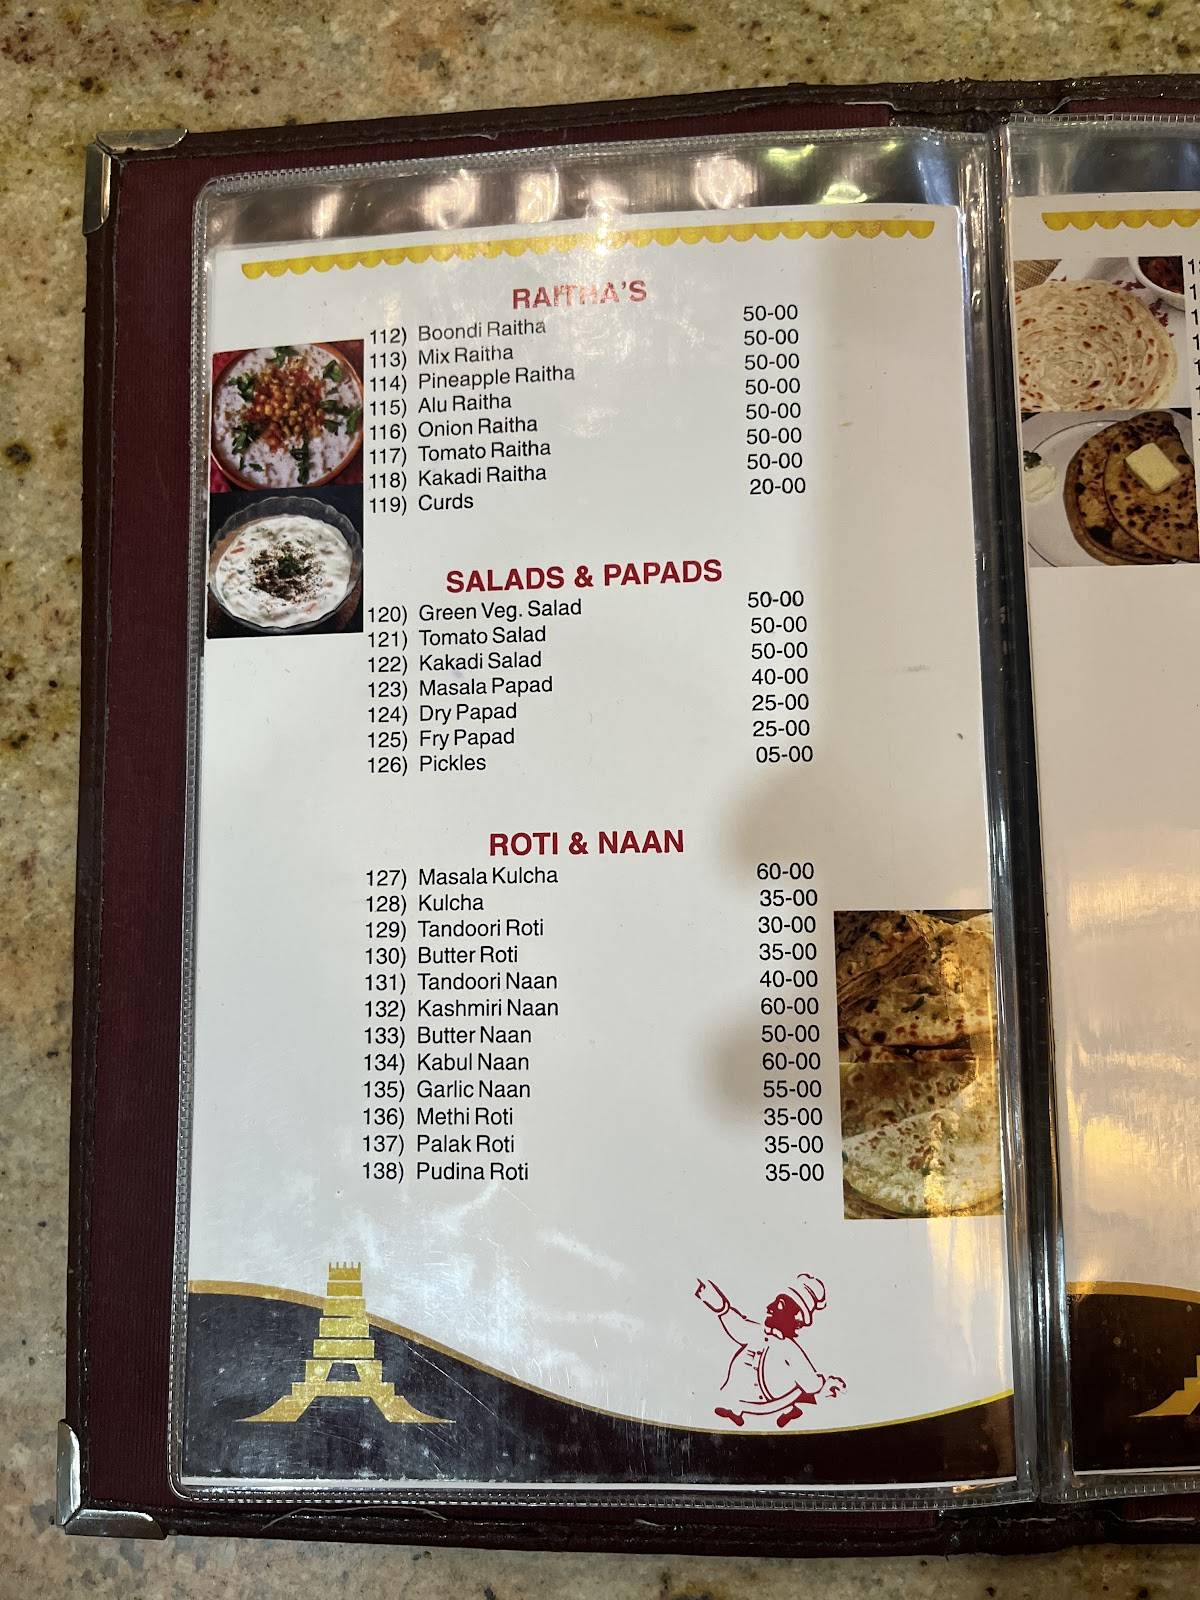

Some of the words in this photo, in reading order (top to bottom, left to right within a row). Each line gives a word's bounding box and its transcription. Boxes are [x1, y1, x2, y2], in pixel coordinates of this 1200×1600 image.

[369, 325, 408, 348] 112)
[418, 321, 482, 342] Boondi
[487, 318, 547, 338] Raitha
[742, 303, 799, 322] 50-00
[369, 349, 407, 372] 113)
[418, 348, 451, 366] Mix
[454, 344, 514, 364] Raitha
[743, 328, 799, 347] 50-00
[369, 373, 408, 396] 114)
[418, 368, 511, 391] Pineapple
[515, 364, 576, 384] Raitha
[744, 352, 800, 371] 50-00
[369, 397, 408, 420] 115)
[417, 396, 448, 414] Alu
[452, 392, 513, 412] Raitha
[744, 377, 801, 396] 50-00
[369, 422, 408, 444] 116)
[417, 420, 473, 438] Onion
[478, 415, 539, 435] Raitha
[745, 402, 802, 421] 50-00
[369, 446, 408, 468] 117)
[417, 443, 487, 462] Tomato
[490, 439, 552, 459] Raitha
[746, 426, 803, 446] 50-00
[369, 470, 408, 493] 118)
[418, 466, 482, 487] Kakadi
[486, 464, 548, 484] Raitha
[746, 451, 803, 471] 50-00
[369, 495, 408, 517] 119)
[417, 492, 474, 512] Curds
[749, 476, 807, 496] 20-00
[446, 565, 565, 594] SALADS
[573, 564, 595, 589] &
[603, 558, 723, 587] PAPADS
[367, 604, 408, 627] 120)
[418, 603, 477, 622] Green
[480, 601, 523, 623] Veg.
[527, 597, 582, 618] Salad
[747, 589, 805, 609] 50-00
[367, 629, 408, 652] 121)
[418, 628, 489, 647] Tomato
[491, 624, 547, 644] Salad
[750, 615, 808, 635] 50-00
[367, 654, 408, 677] 122)
[419, 652, 484, 672] Kakadi
[487, 649, 542, 670] Salad
[751, 641, 809, 660] 50-00
[367, 679, 408, 702] 123)
[419, 677, 488, 697] Masala
[491, 675, 553, 698] Papad
[751, 667, 809, 686] 40-00
[367, 704, 408, 727] 124)
[419, 704, 453, 726] Dry
[456, 701, 517, 725] Papad
[751, 692, 810, 712] 25-00
[367, 729, 408, 752] 125)
[419, 729, 450, 751] Fry
[453, 727, 515, 750] Papad
[752, 719, 811, 738] 25-00
[367, 755, 408, 777] 126)
[419, 753, 487, 773] Pickles
[755, 745, 814, 764] 05-00
[489, 831, 559, 857] ROTI
[568, 831, 590, 856] &
[598, 829, 684, 855] NAAN
[365, 868, 407, 891] 127)
[418, 867, 489, 886] Masala
[492, 865, 559, 885] Kulcha
[756, 861, 815, 881] 60-00
[365, 894, 407, 917] 128)
[418, 892, 485, 912] Kulcha
[759, 888, 818, 908] 35-00
[365, 920, 407, 944] 129)
[416, 919, 501, 938] Tandoori
[505, 918, 544, 937] Roti
[758, 915, 817, 934] 30-00
[364, 946, 407, 969] 130)
[418, 946, 477, 965] Butter
[480, 945, 518, 964] Roti
[758, 942, 818, 962] 35-00
[364, 972, 406, 996] 131)
[416, 971, 501, 991] Tandoori
[505, 971, 558, 990] Naan
[759, 969, 819, 988] 40-00
[364, 999, 406, 1023] 132)
[417, 998, 502, 1018] Kashmiri
[507, 998, 559, 1017] Naan
[760, 996, 820, 1016] 60-00
[364, 1025, 406, 1049] 133)
[417, 1025, 477, 1045] Butter
[479, 1025, 532, 1044] Naan
[761, 1024, 821, 1044] 50-00
[363, 1052, 406, 1076] 134)
[417, 1051, 473, 1072] Kabul
[477, 1052, 530, 1071] Naan
[762, 1051, 821, 1071] 60-00
[363, 1079, 406, 1103] 135)
[416, 1079, 475, 1099] Garlic
[478, 1079, 531, 1099] Naan
[762, 1079, 822, 1099] 55-00
[362, 1106, 405, 1131] 136)
[416, 1106, 470, 1126] Methi
[475, 1106, 513, 1126] Roti
[763, 1107, 823, 1127] 35-00
[362, 1133, 405, 1158] 137)
[416, 1133, 472, 1153] Palak
[476, 1134, 515, 1154] Roti
[764, 1135, 824, 1154] 35-00
[362, 1161, 405, 1185] 138)
[416, 1161, 486, 1181] Pudina
[490, 1161, 529, 1181] Roti
[765, 1162, 825, 1182] 35-00
